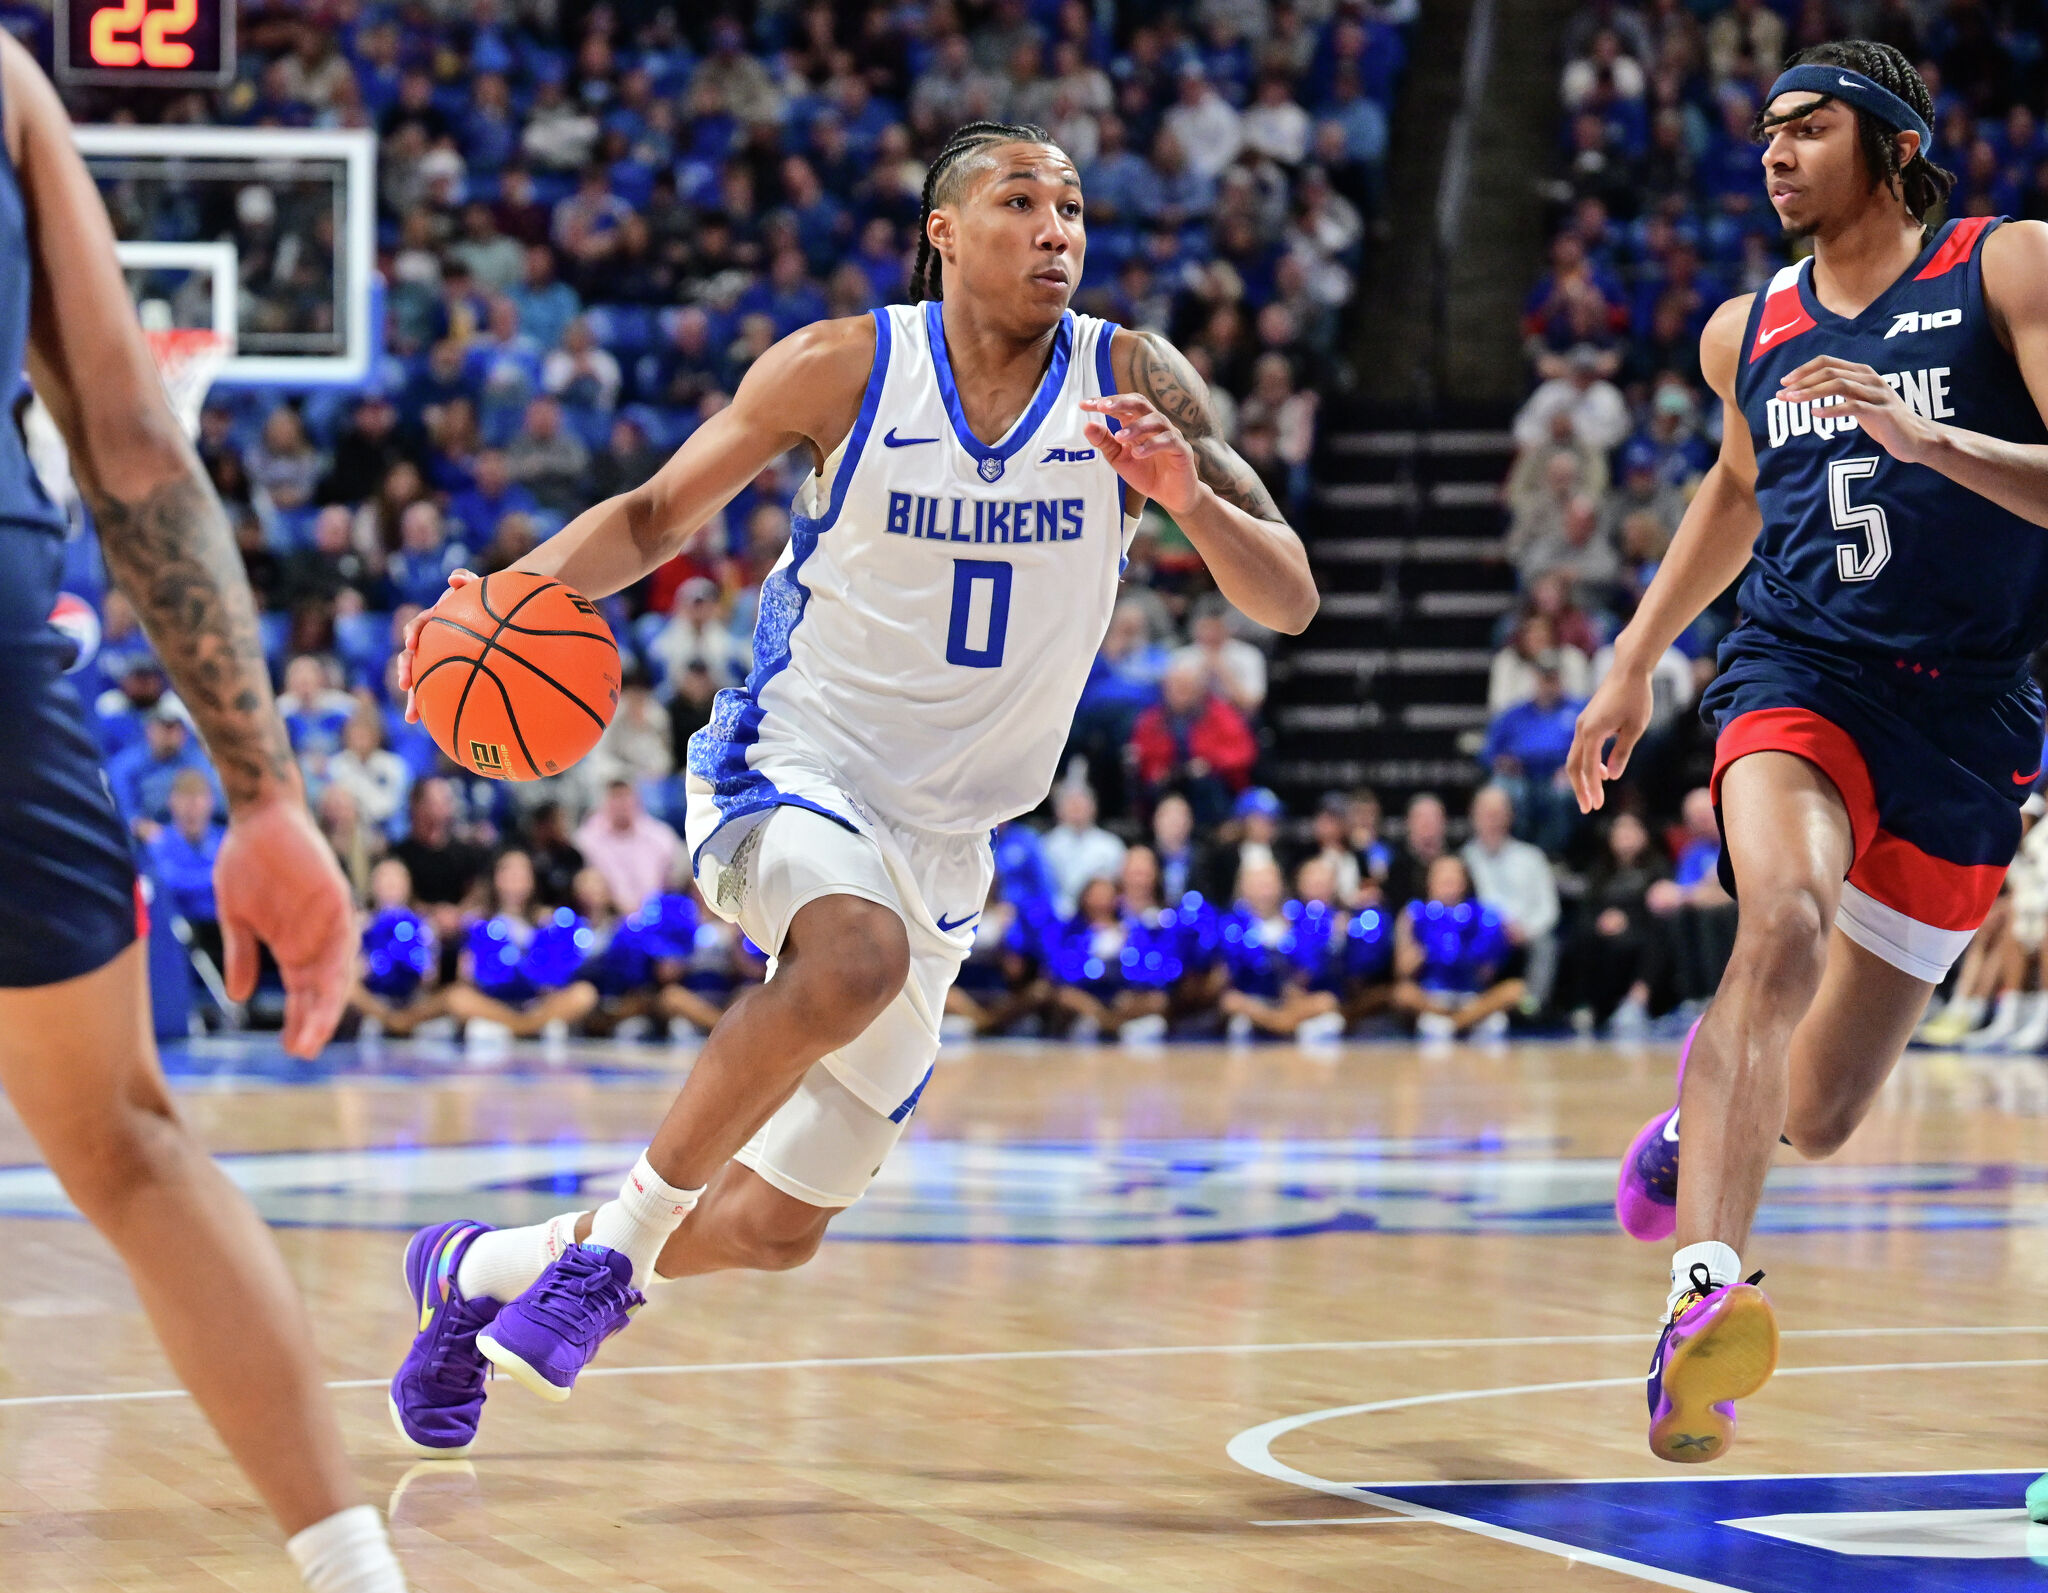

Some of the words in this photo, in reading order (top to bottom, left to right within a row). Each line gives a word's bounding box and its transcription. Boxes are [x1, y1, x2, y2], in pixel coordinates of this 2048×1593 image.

[90, 0, 198, 68] 22
[1883, 308, 1962, 340] A10
[1040, 448, 1096, 464] A10
[884, 490, 1084, 544] BILLIKENS
[1828, 455, 1892, 583] 5
[946, 558, 1013, 668] 0
